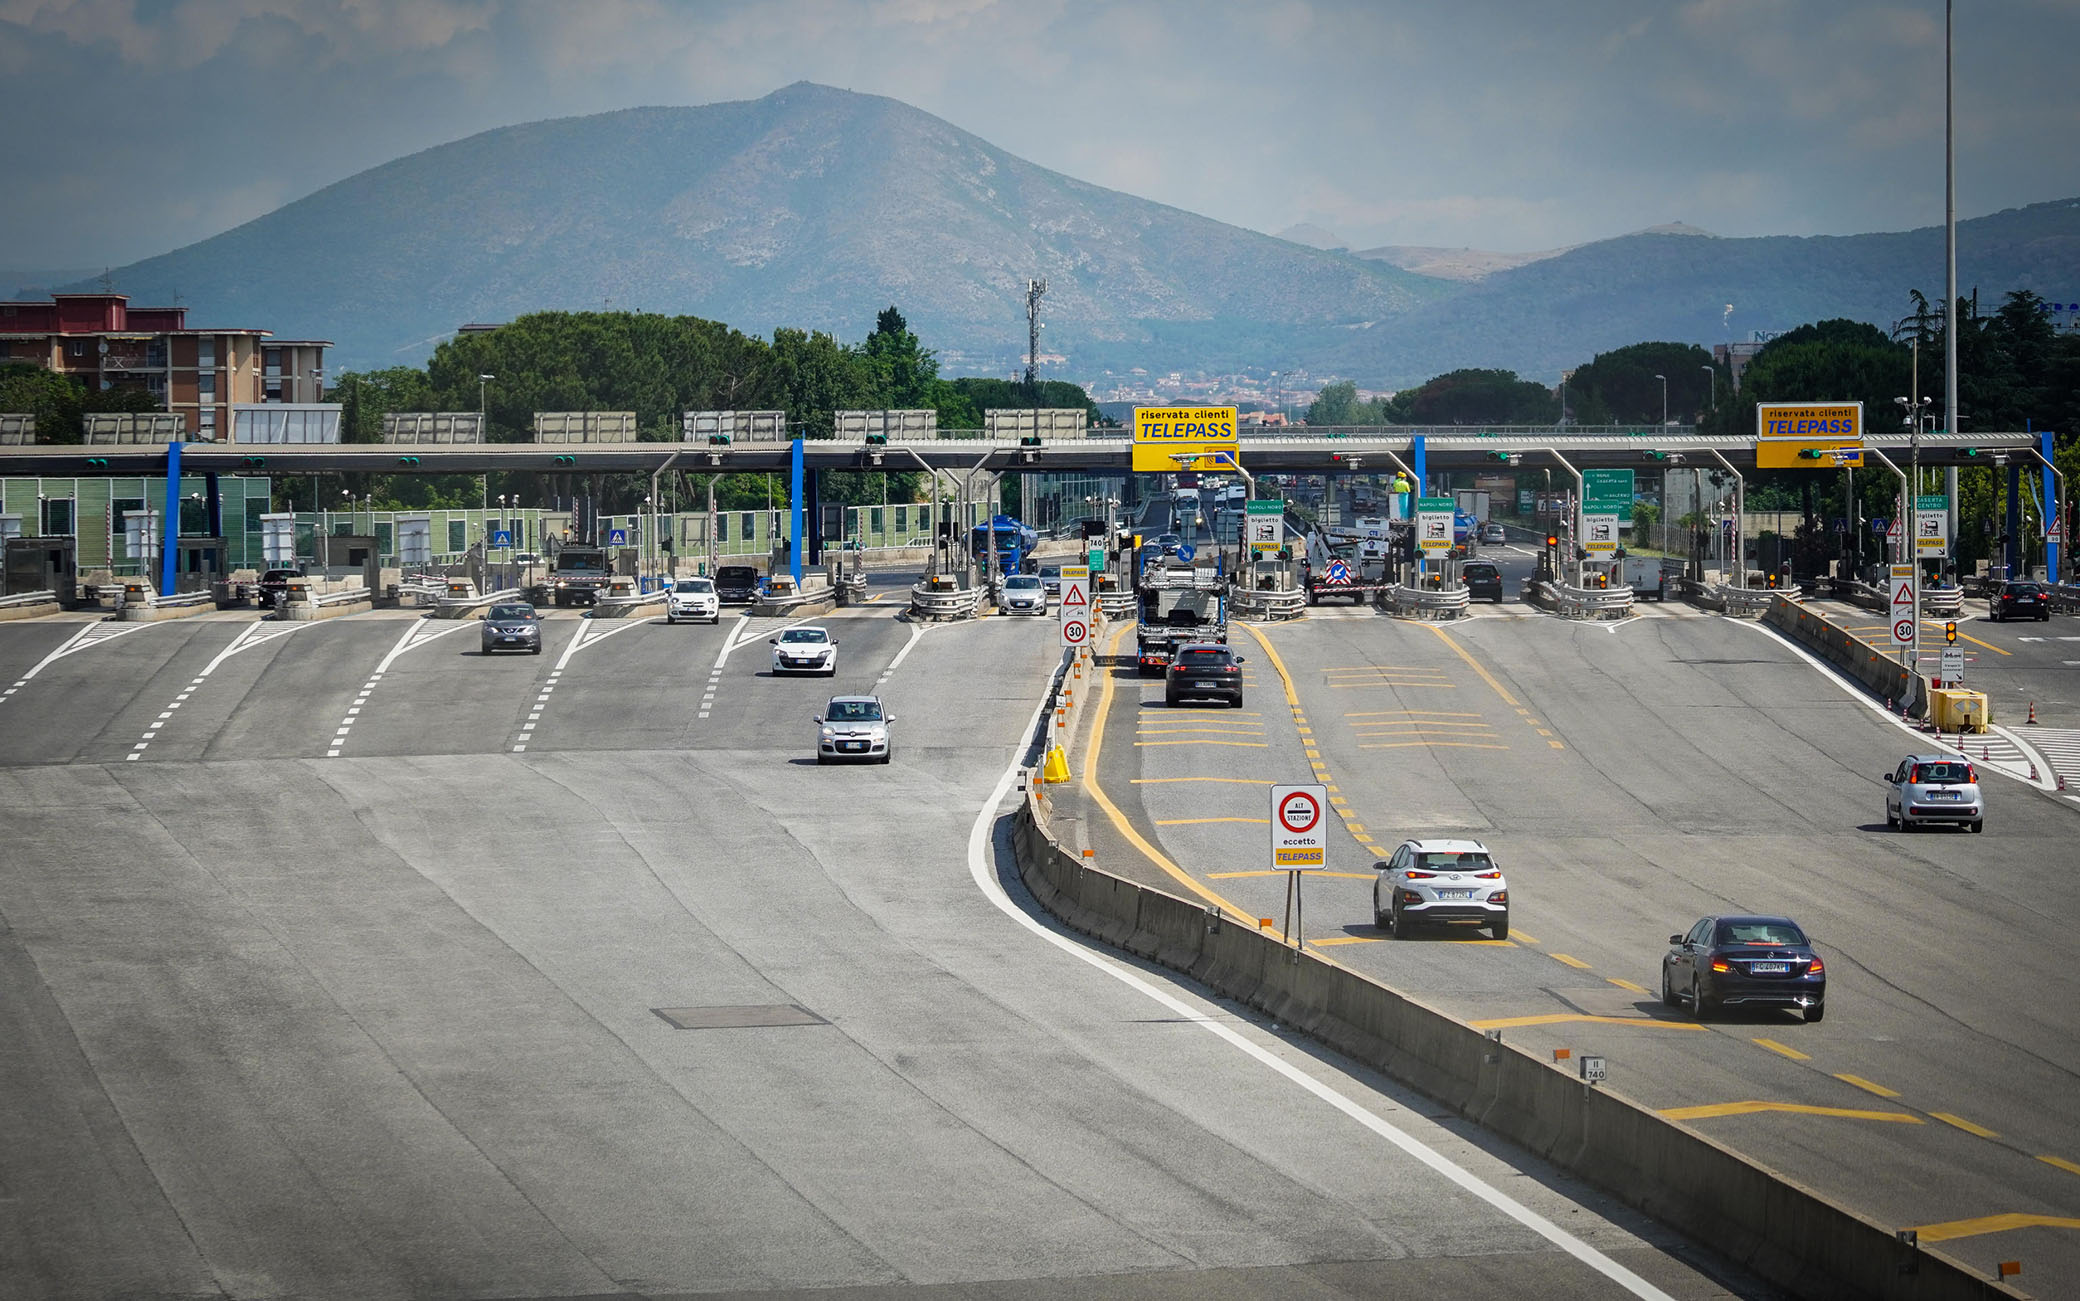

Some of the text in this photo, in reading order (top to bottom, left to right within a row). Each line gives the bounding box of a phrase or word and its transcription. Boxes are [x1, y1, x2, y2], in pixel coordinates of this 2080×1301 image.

[1141, 410, 1230, 420] riservata clienti
[1770, 408, 1852, 418] riservata clienti
[1142, 422, 1232, 438] TELEPASS
[1768, 420, 1852, 434] TELEPASS
[1069, 626, 1081, 636] 30
[1899, 626, 1911, 636] 30
[1278, 852, 1321, 861] TELEPASS
